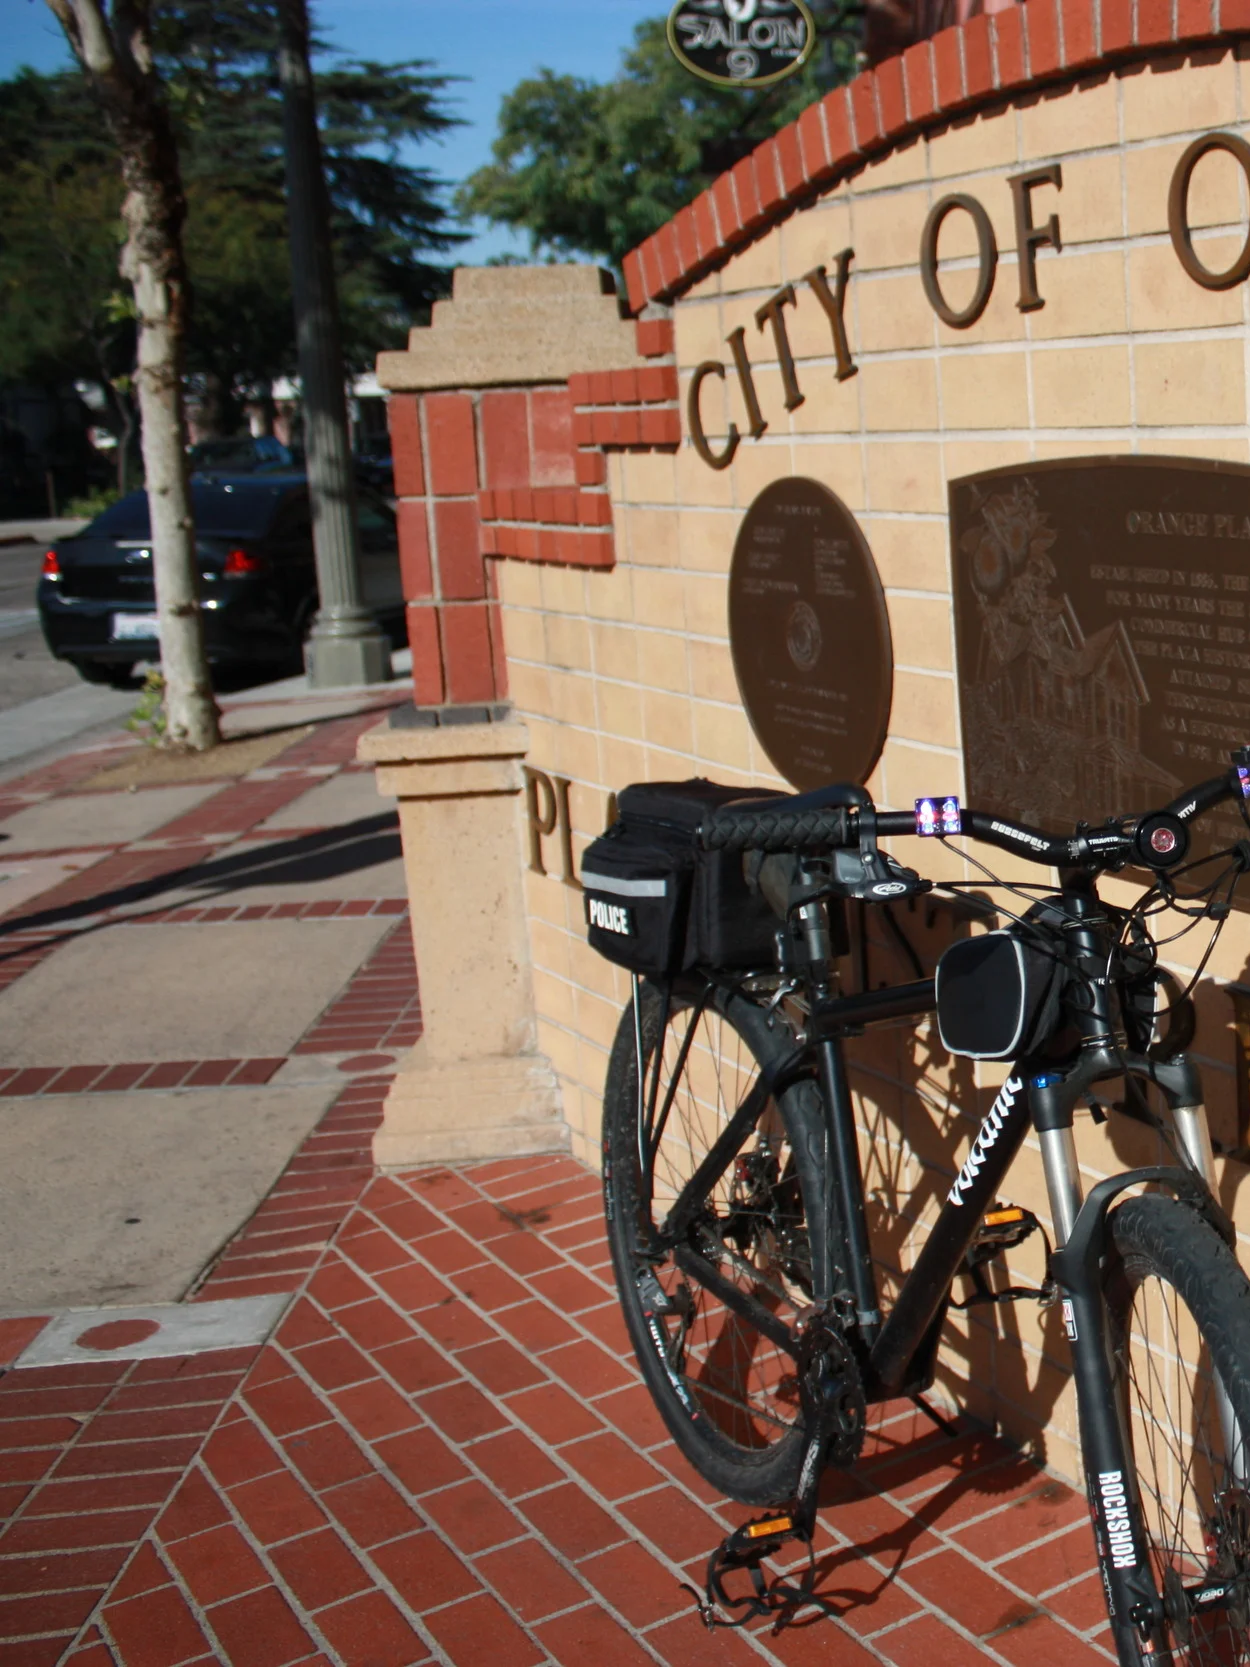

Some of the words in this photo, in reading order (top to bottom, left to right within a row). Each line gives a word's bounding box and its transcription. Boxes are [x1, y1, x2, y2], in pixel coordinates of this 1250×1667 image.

[676, 13, 806, 49] SALON
[725, 48, 760, 80] 9
[687, 248, 858, 472] CITY
[919, 163, 1064, 330] OF
[1126, 510, 1209, 537] ORANGE
[1221, 573, 1250, 592] THE
[1136, 592, 1171, 611] MANY
[1173, 595, 1215, 615] YEARS
[1218, 599, 1245, 618] THE
[1130, 616, 1213, 640] COMMERCIAL
[1217, 625, 1246, 644] HUB
[1160, 641, 1201, 663] PLAZA
[1178, 717, 1188, 733] A
[589, 899, 629, 936] POLICE
[1098, 1469, 1137, 1569] ROCKSHOX
